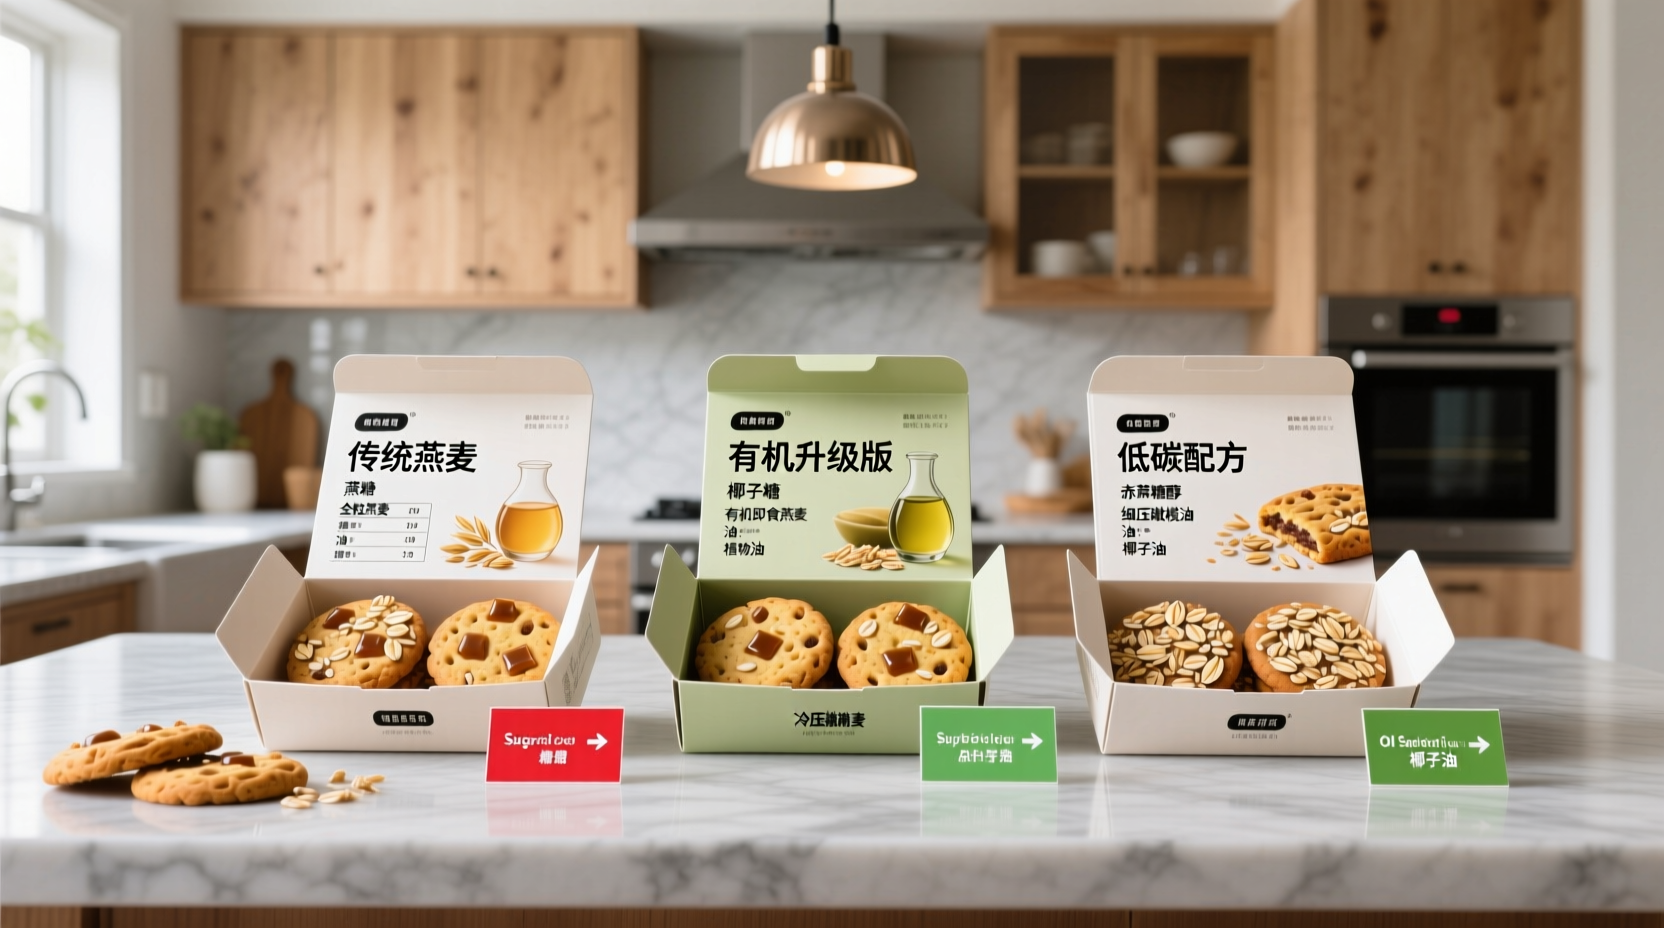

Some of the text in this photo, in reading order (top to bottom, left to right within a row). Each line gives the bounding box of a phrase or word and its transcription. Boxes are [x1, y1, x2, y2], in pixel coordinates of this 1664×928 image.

[348, 440, 477, 473] 传统燕麦
[729, 440, 893, 473] 有机升级版
[1117, 440, 1247, 473] 低碳配方
